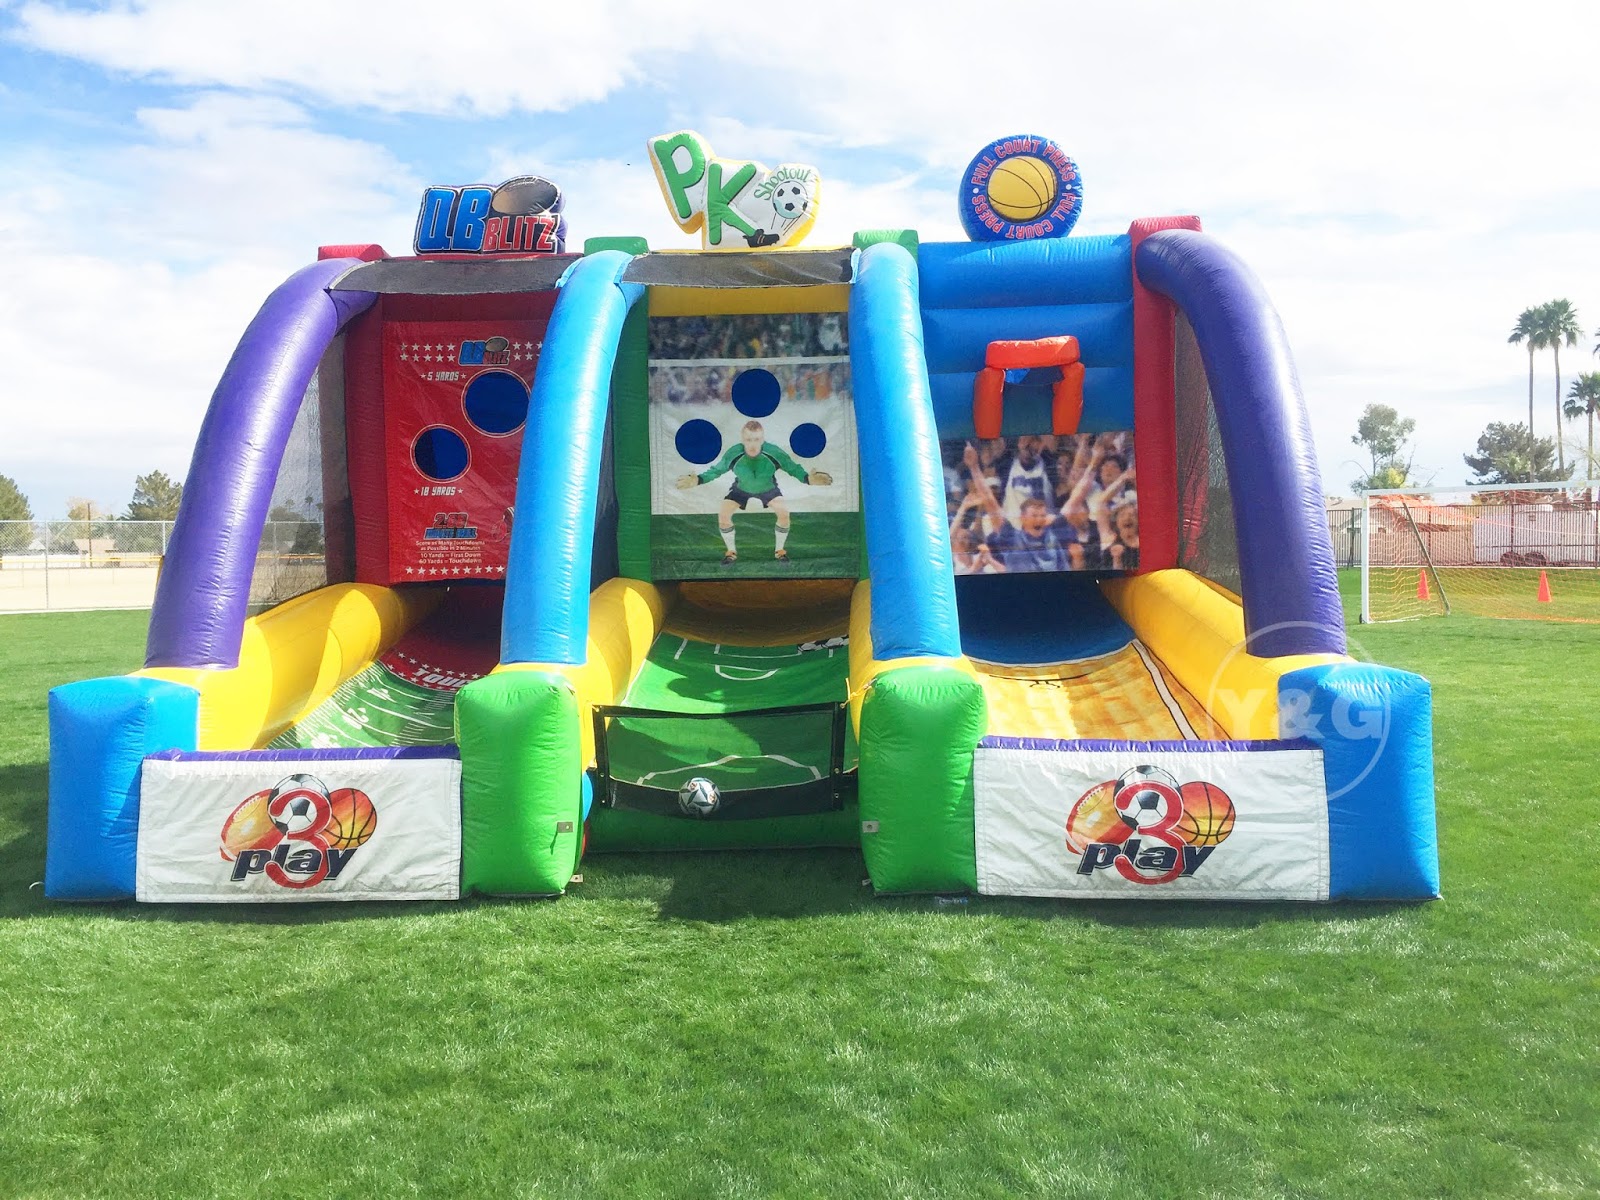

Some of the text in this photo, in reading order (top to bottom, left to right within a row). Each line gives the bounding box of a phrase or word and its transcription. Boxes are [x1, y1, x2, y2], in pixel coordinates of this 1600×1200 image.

[971, 139, 1076, 185] FULL COURT PRESS
[653, 133, 757, 246] PK
[754, 166, 811, 201] Shootout
[417, 187, 491, 252] QB
[482, 214, 558, 252] BLITZ
[972, 192, 1076, 239] FULL COURT PRESS
[427, 371, 459, 381] 5 YARDS
[431, 486, 456, 496] YARDS
[265, 788, 333, 889] 3
[1113, 780, 1187, 885] 3
[230, 844, 358, 882] play
[1077, 839, 1216, 877] play
